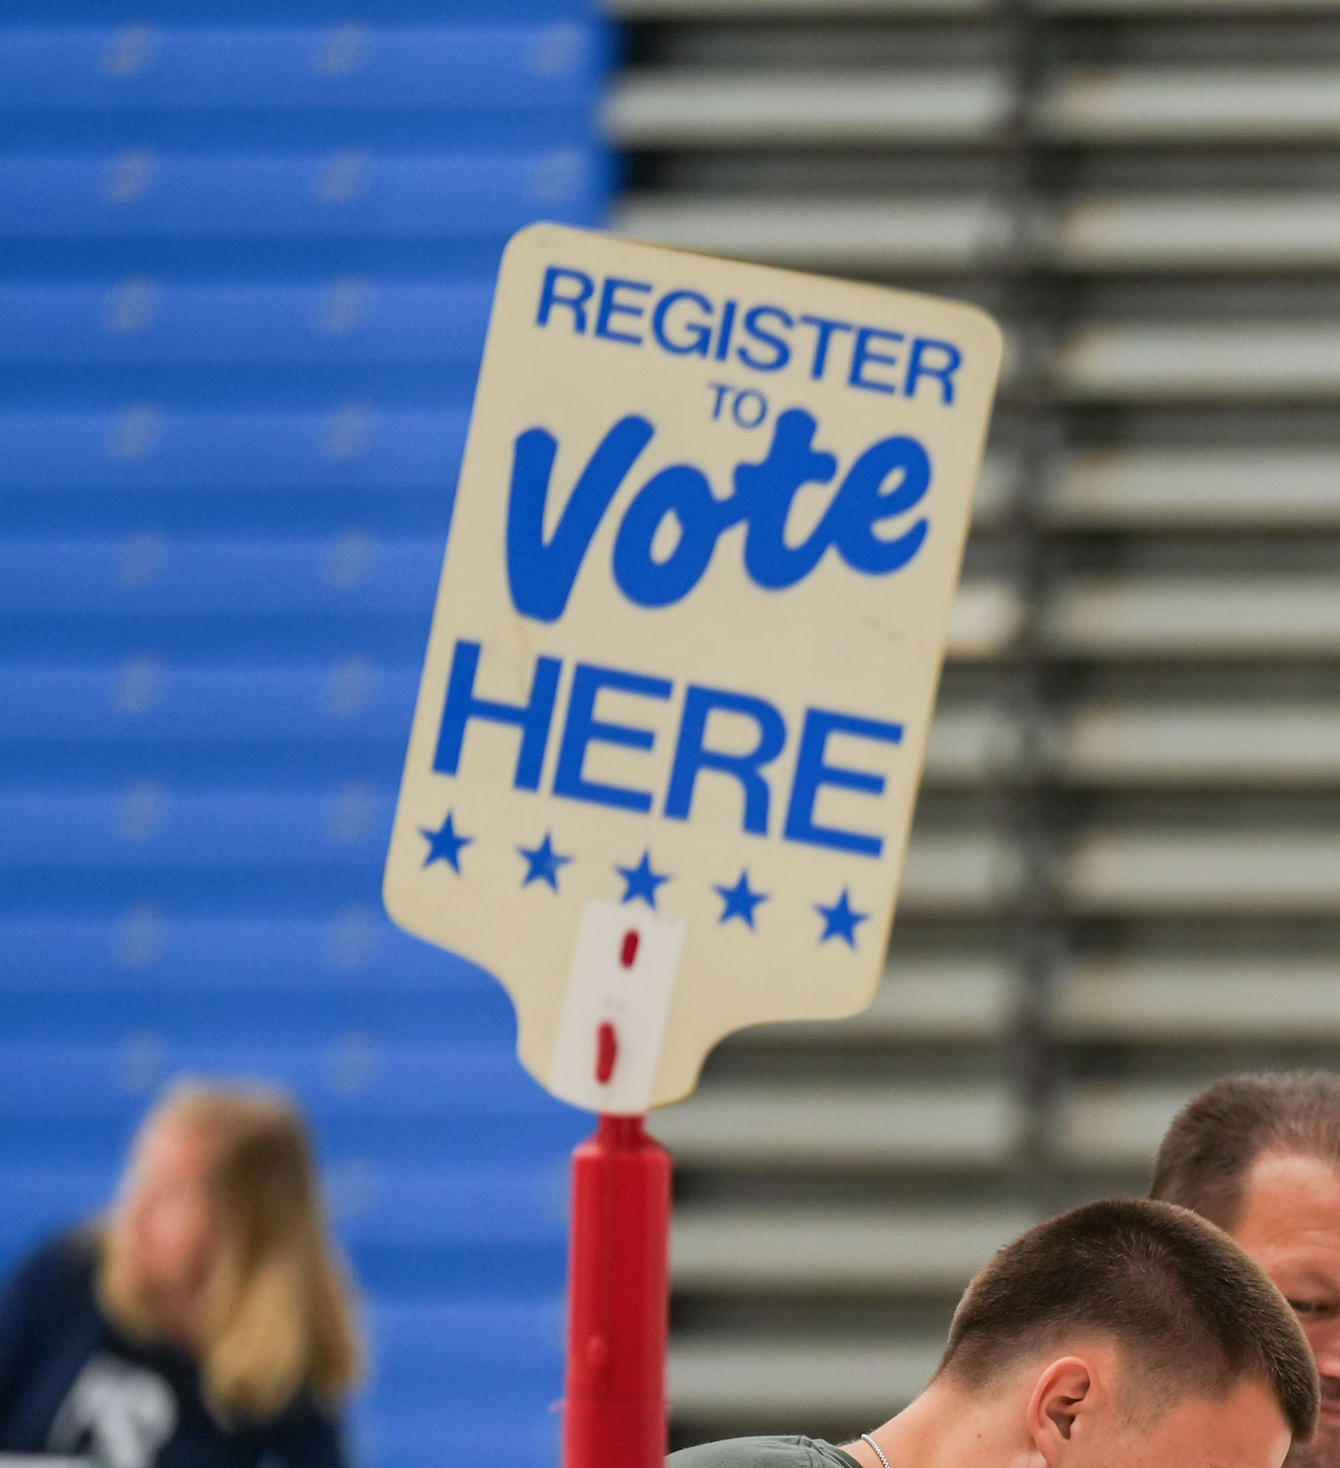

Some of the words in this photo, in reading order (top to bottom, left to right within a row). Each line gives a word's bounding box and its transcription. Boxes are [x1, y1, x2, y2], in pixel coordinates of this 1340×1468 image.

[537, 267, 963, 405] REGISTER
[707, 382, 770, 431] TO
[506, 408, 932, 624] Vote
[432, 640, 904, 858] HERE
